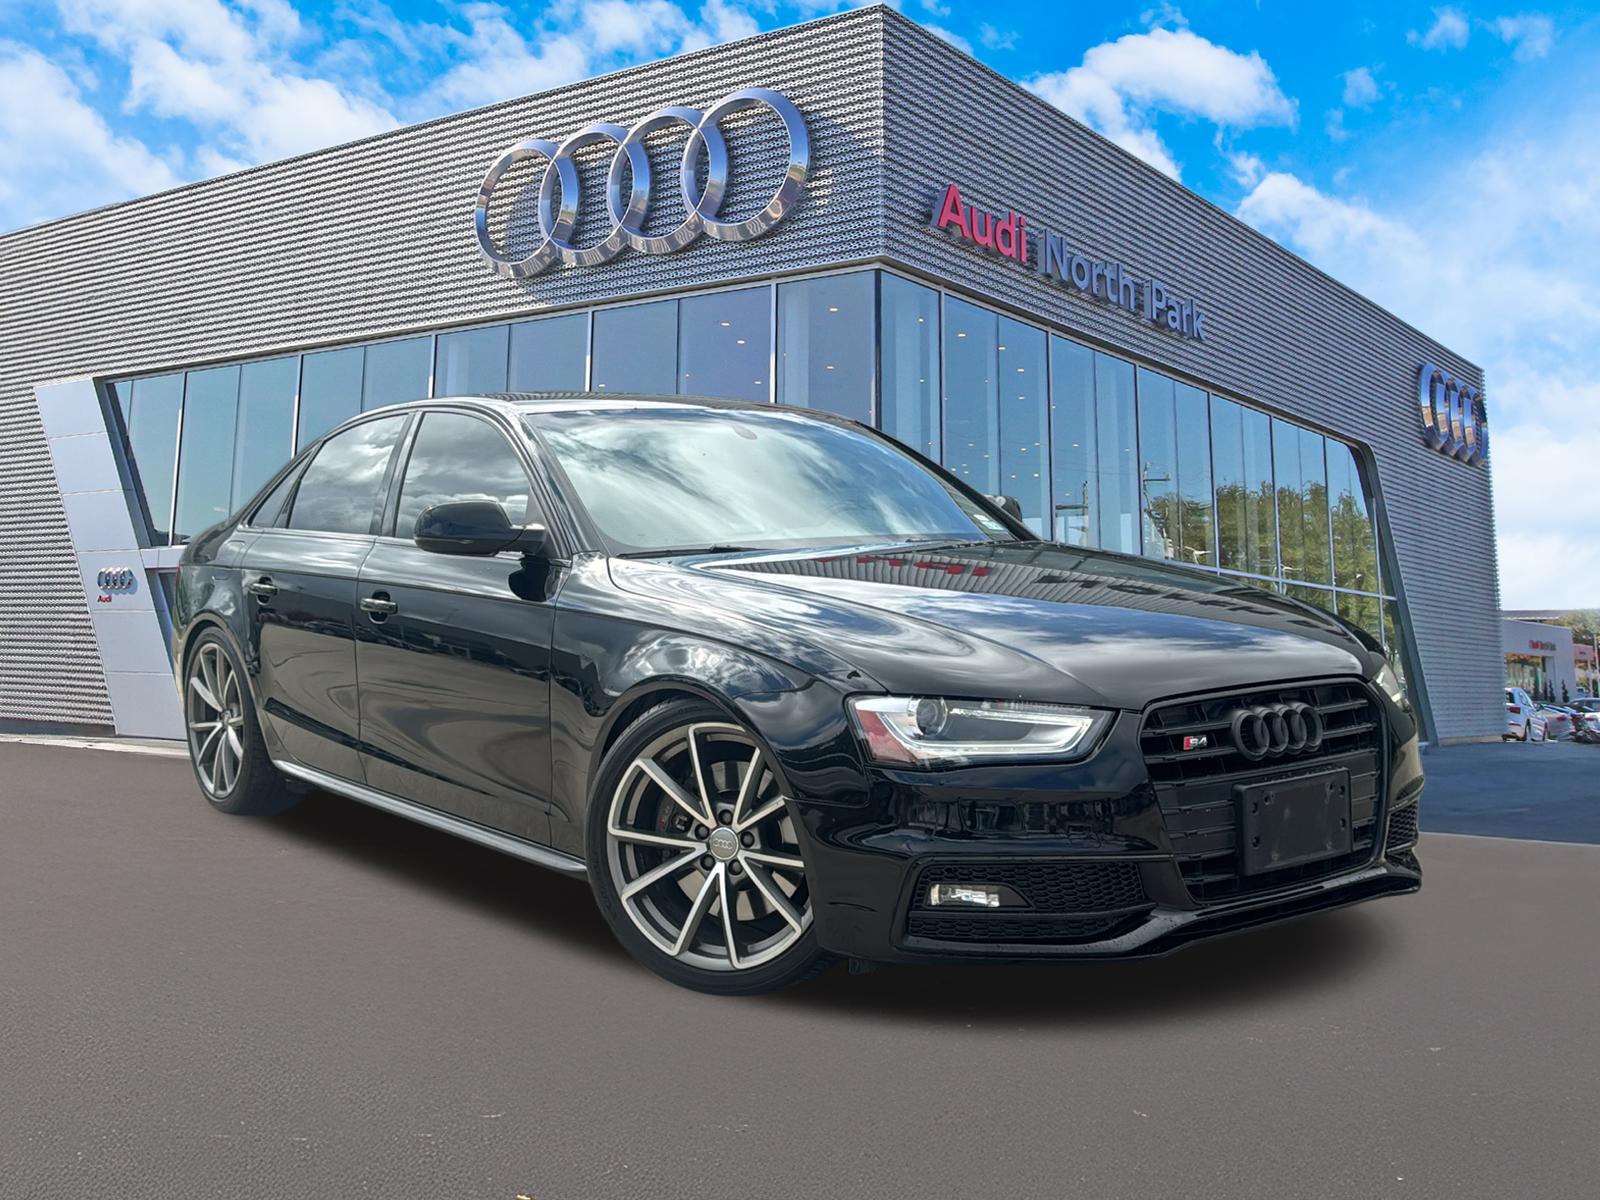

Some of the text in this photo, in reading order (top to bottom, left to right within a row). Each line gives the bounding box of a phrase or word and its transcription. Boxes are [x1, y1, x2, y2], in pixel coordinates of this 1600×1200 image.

[932, 183, 1206, 341] Audi North Park
[1188, 735, 1208, 748] S4
